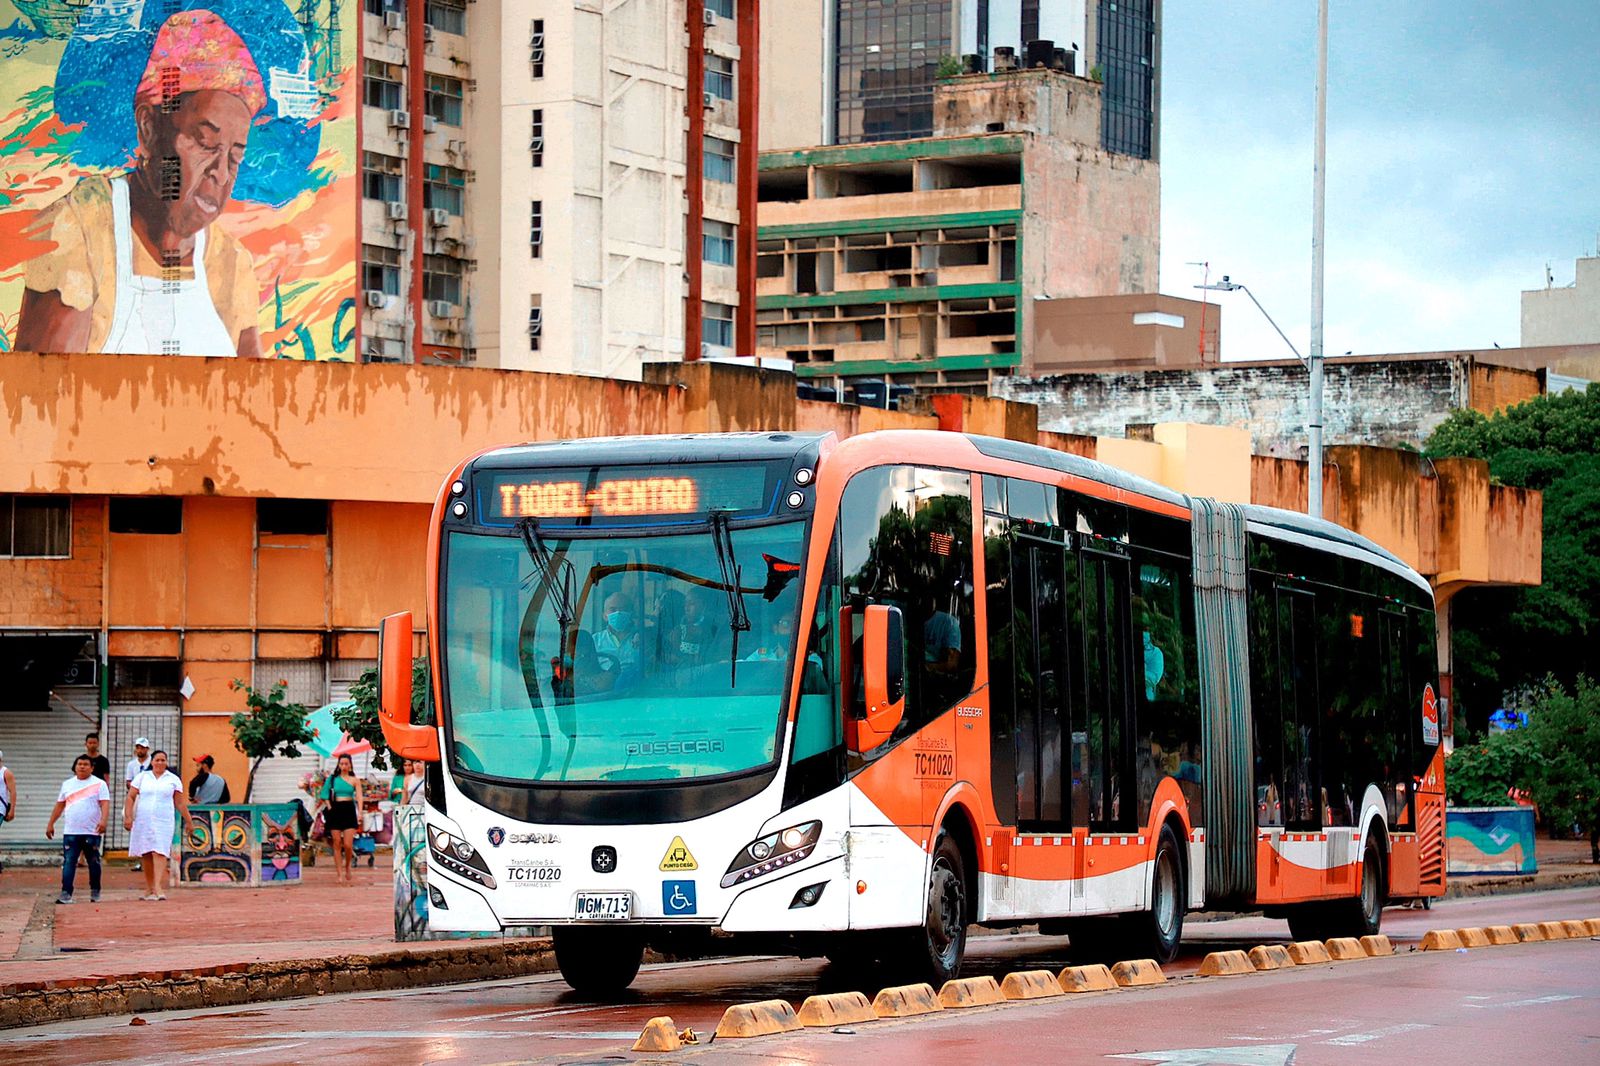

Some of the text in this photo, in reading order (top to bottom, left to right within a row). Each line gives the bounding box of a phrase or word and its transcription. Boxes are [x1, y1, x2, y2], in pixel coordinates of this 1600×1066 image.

[626, 739, 724, 756] BUSSCAR
[915, 753, 953, 776] TC11020
[508, 833, 562, 844] SCANIA
[508, 868, 562, 880] TC11020
